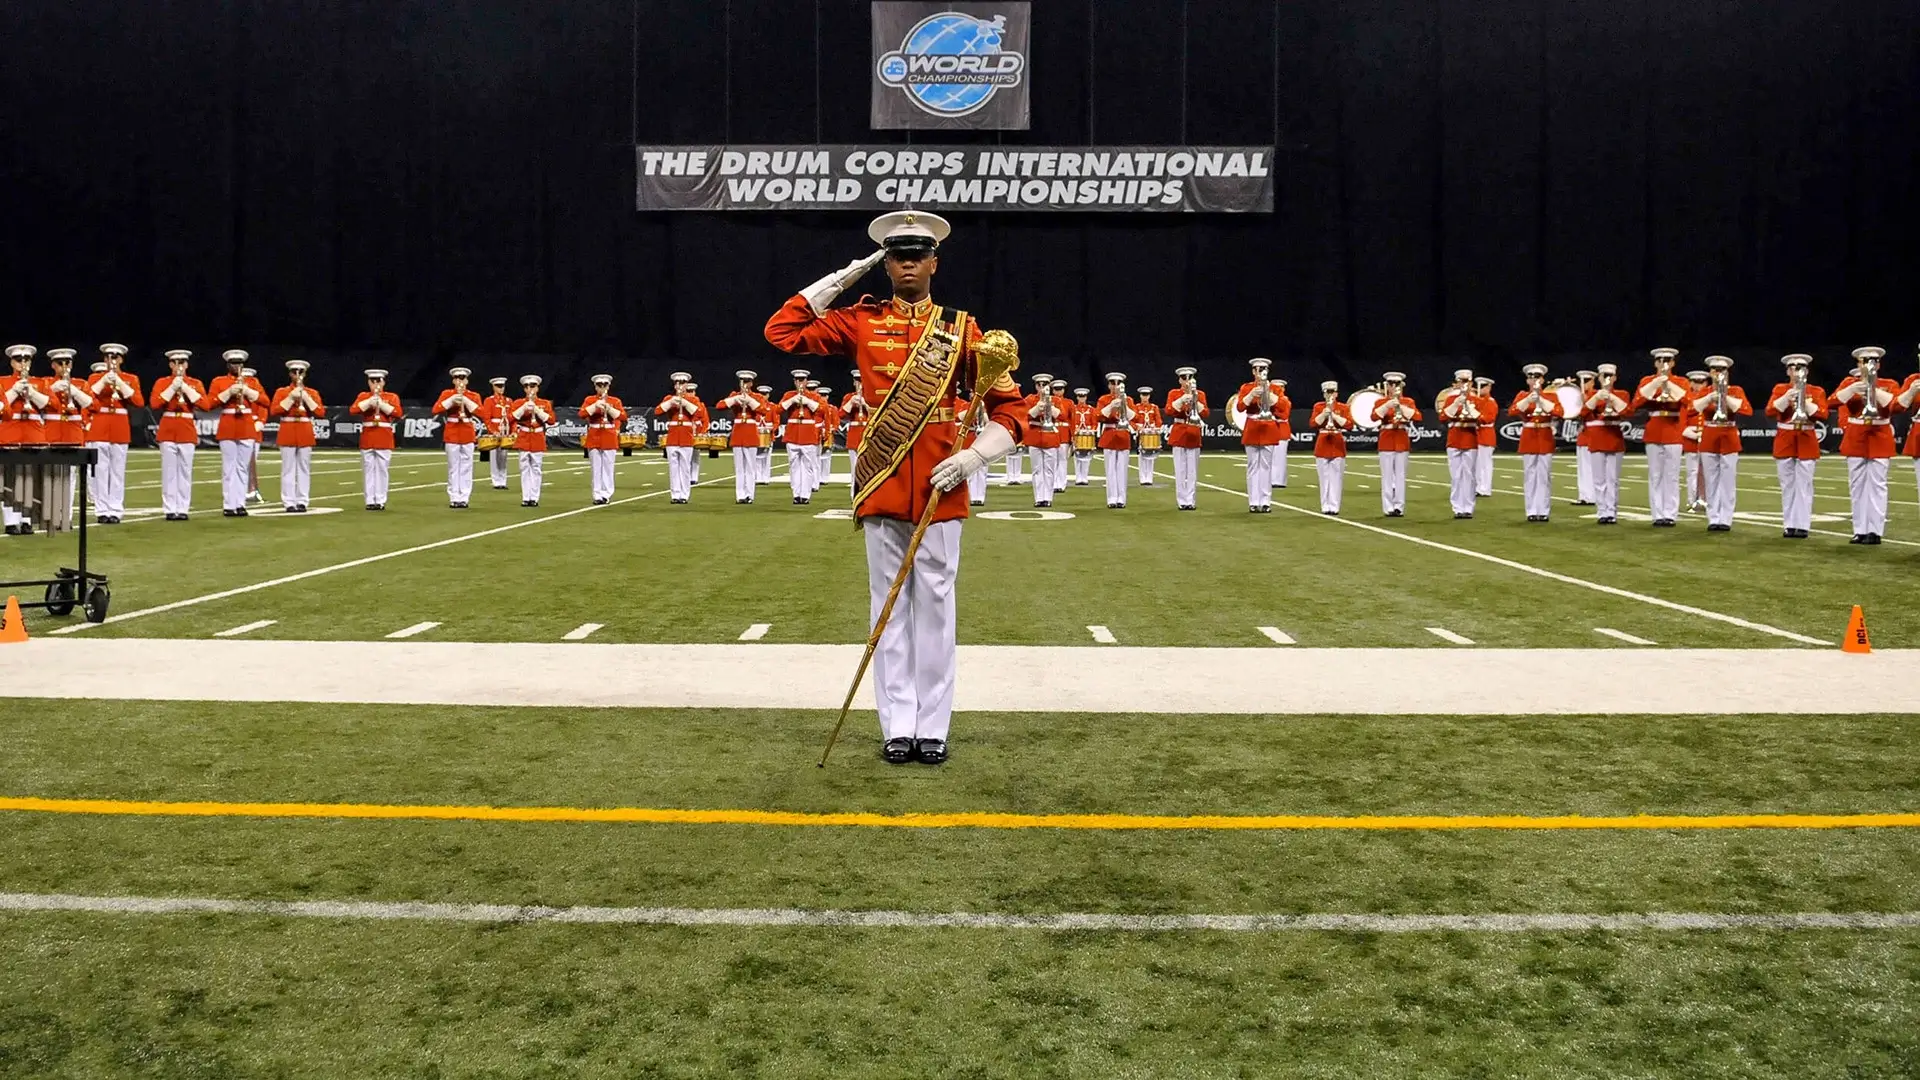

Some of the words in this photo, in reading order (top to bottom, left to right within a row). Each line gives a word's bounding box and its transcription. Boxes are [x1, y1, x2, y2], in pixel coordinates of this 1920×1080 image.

[909, 56, 1020, 73] WORLD
[908, 74, 1016, 83] CHAMPIONSHIPS
[643, 152, 707, 175] THE
[720, 152, 830, 175] DRUM
[845, 152, 964, 175] CORPS
[977, 152, 1268, 177] INTERNATIONAL
[728, 179, 862, 202] WORLD
[875, 179, 1184, 204] CHAMPIONSHIPS
